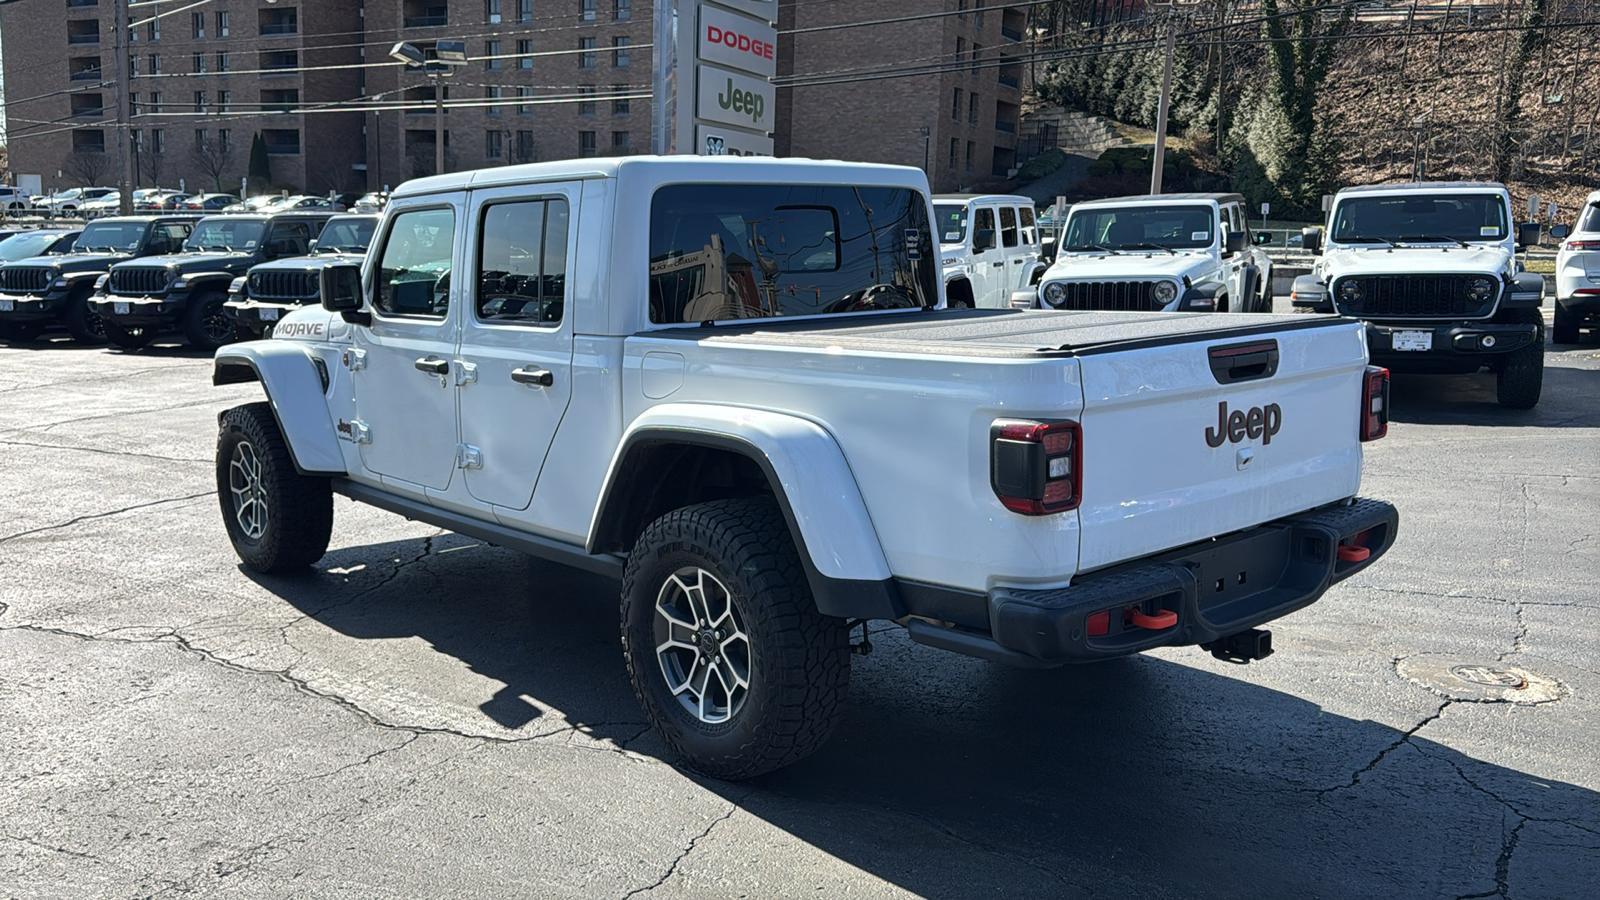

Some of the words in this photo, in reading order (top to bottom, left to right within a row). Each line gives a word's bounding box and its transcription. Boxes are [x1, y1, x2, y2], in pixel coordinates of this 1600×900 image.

[708, 26, 774, 60] DODGE
[718, 77, 764, 123] Jeep
[275, 322, 324, 337] MOJAVE
[1205, 401, 1282, 448] Jeep
